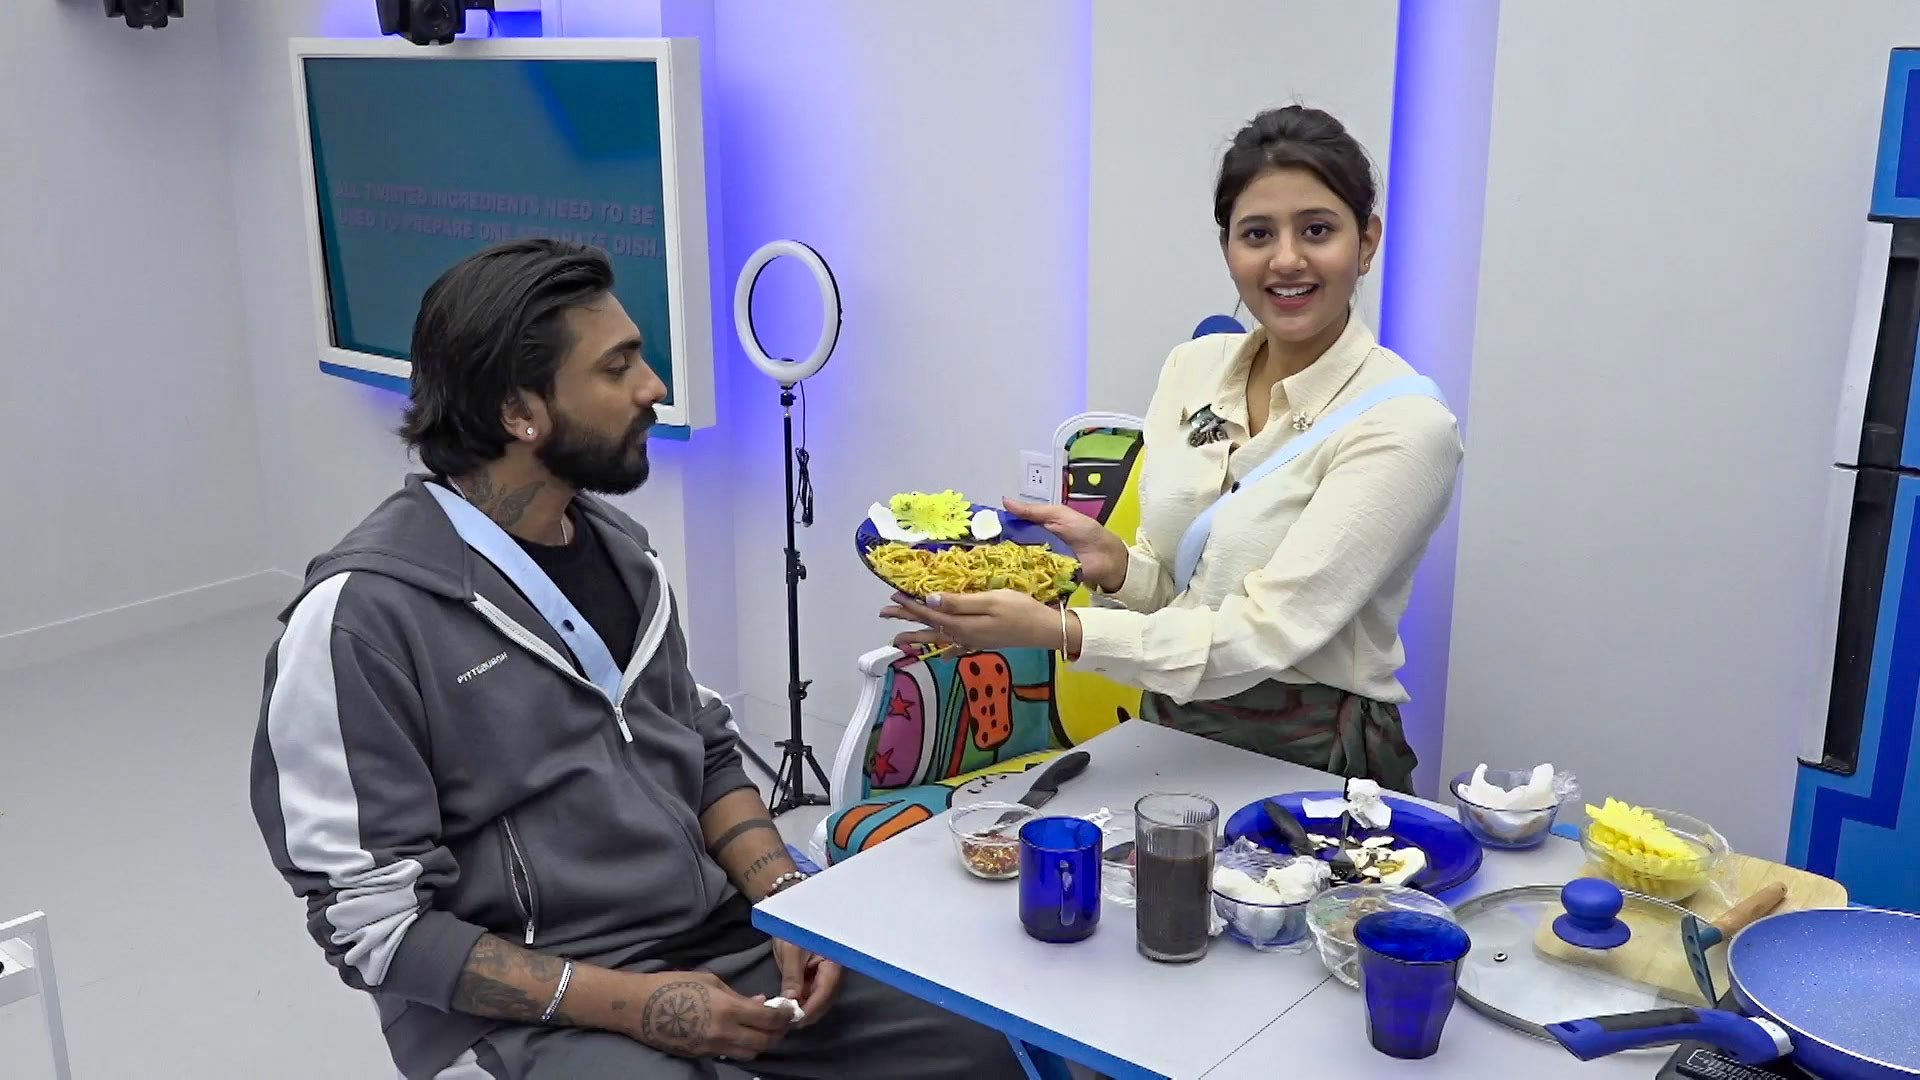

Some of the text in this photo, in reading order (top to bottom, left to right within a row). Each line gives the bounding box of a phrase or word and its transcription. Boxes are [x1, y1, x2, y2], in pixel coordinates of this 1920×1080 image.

[365, 184, 427, 205] TWISTED
[432, 188, 541, 216] INGREDIENTS
[546, 197, 593, 221] NEED
[600, 202, 624, 224] TO
[630, 205, 657, 226] BE
[406, 216, 473, 240] PREPARE
